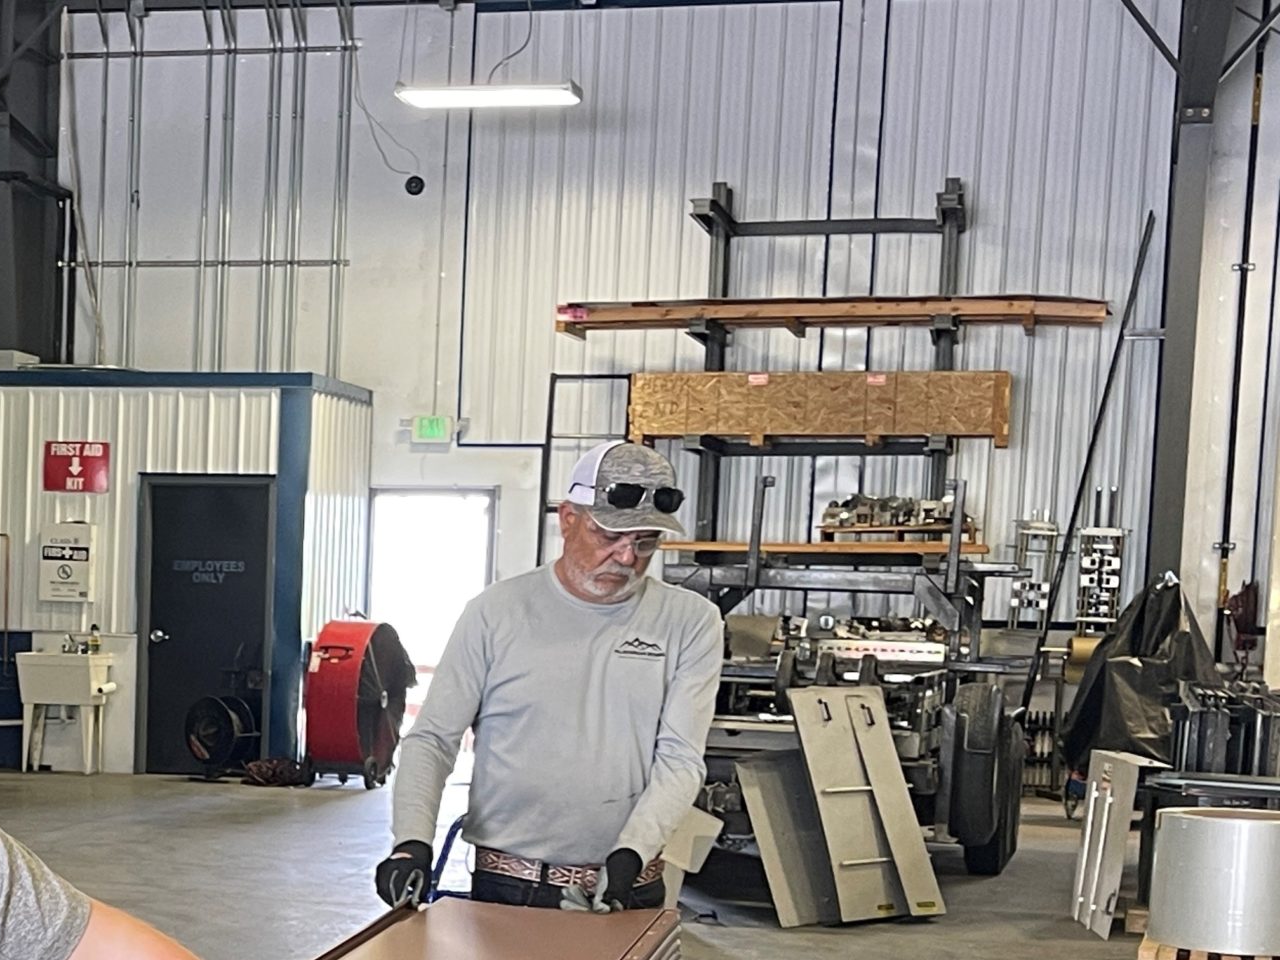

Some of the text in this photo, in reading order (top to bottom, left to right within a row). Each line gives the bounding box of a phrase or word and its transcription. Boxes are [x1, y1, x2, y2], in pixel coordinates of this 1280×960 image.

[50, 443, 103, 457] FIRST AID
[65, 477, 84, 490] KIT
[173, 560, 245, 573] EMPLOYEES
[192, 571, 225, 584] ONLY
